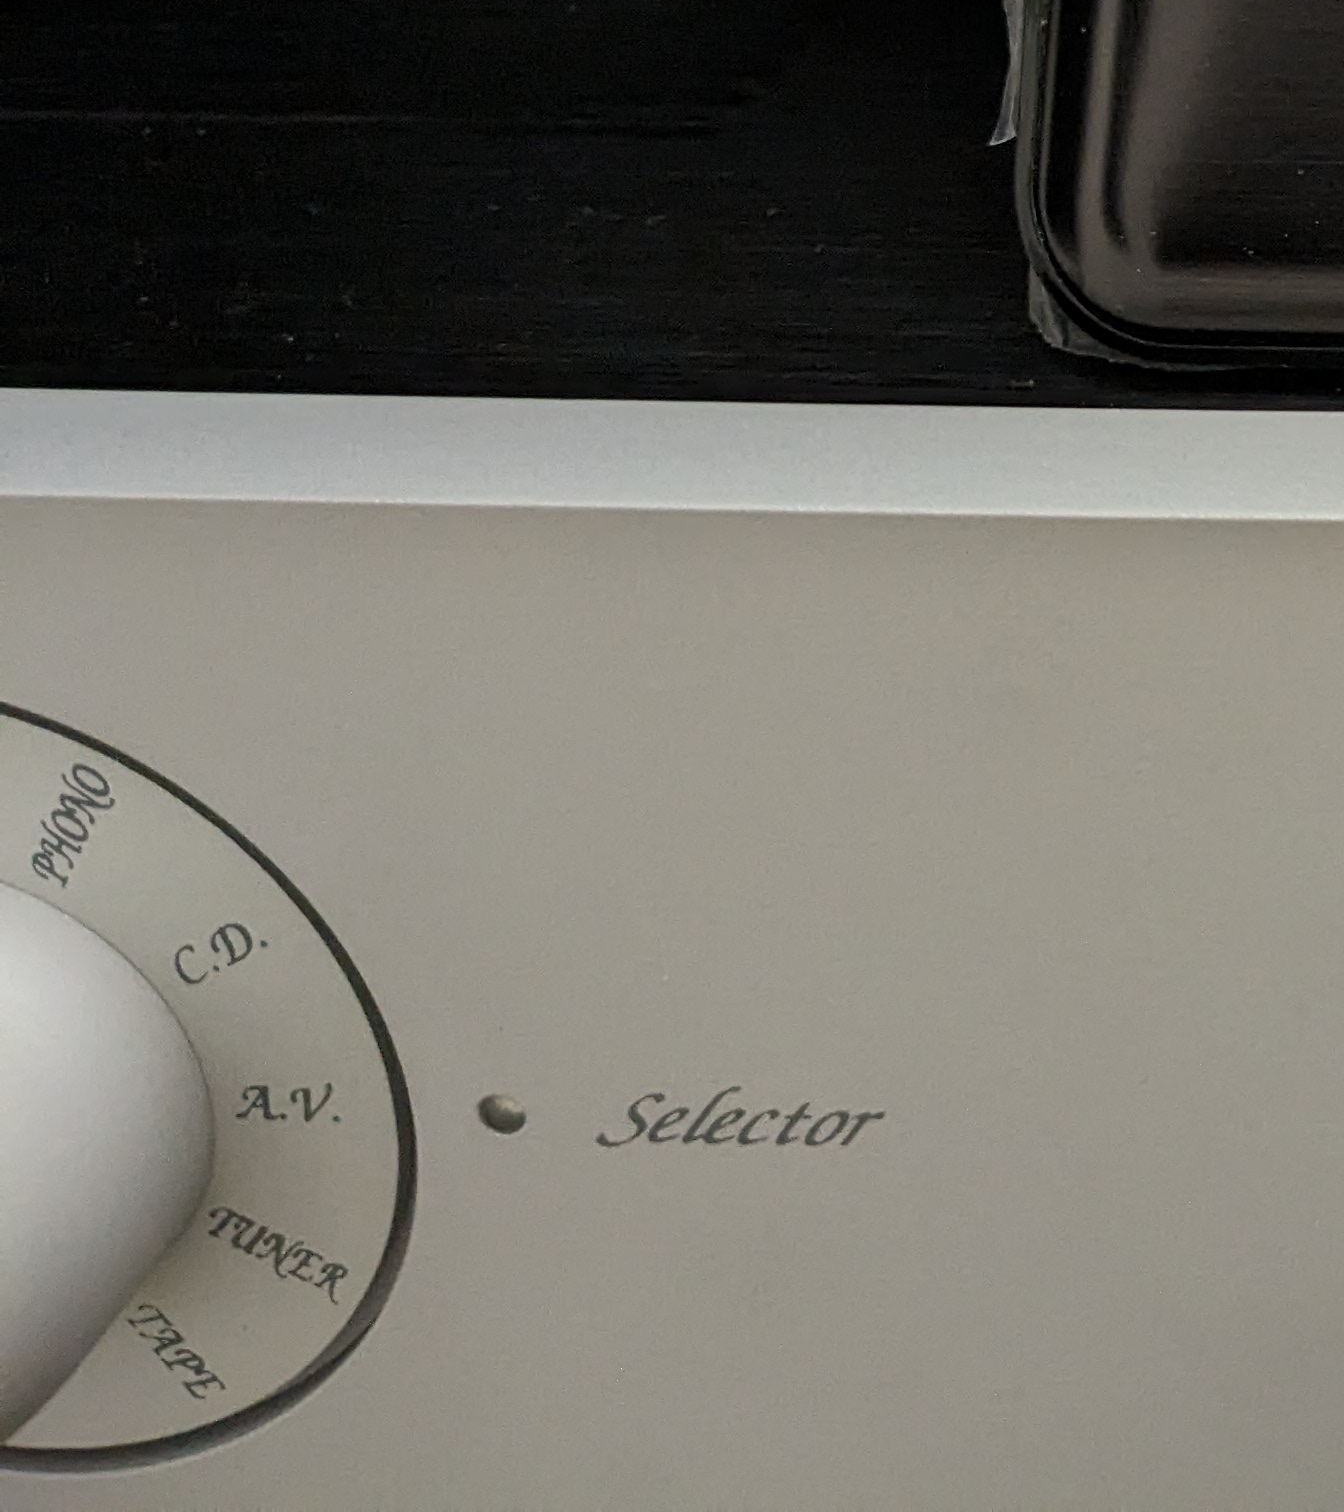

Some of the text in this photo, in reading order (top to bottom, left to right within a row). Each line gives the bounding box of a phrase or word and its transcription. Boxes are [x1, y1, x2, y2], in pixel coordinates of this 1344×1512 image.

[30, 762, 119, 888] PHONO
[173, 921, 269, 986] C.D.
[235, 1082, 341, 1124] A.V.
[595, 1085, 887, 1149] Selector
[207, 1202, 350, 1305] TUNER
[126, 1301, 228, 1401] TAPE
